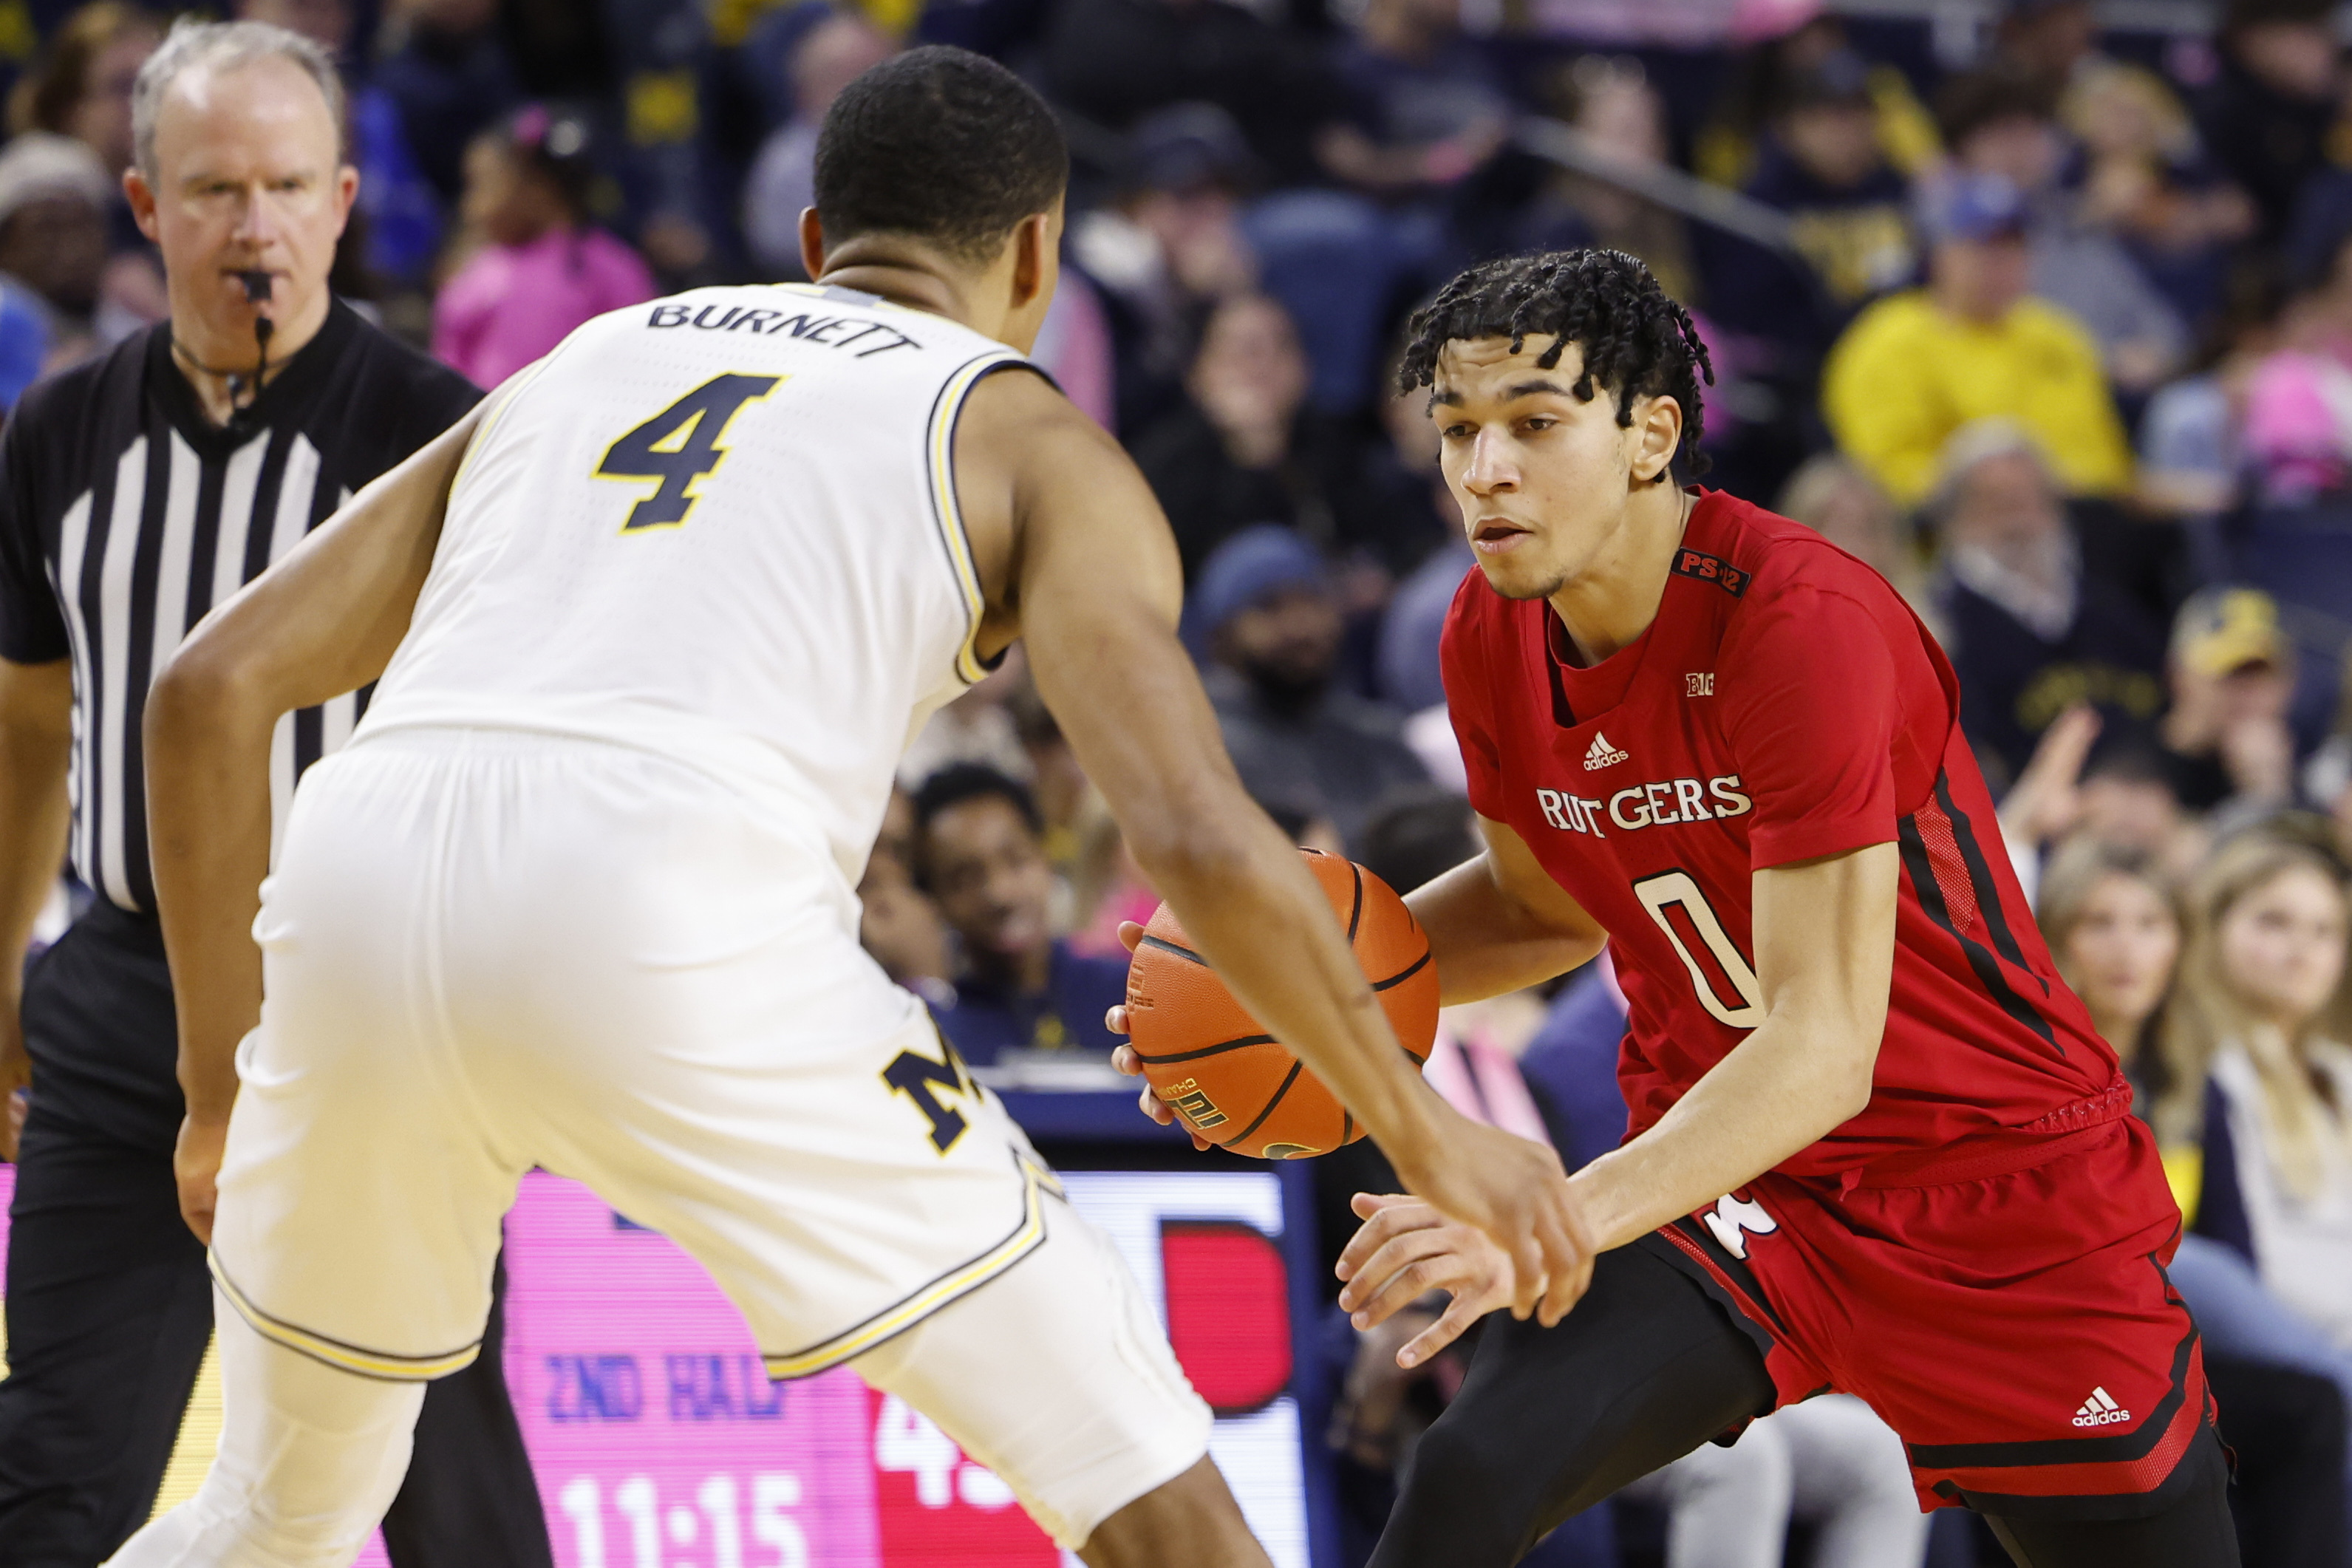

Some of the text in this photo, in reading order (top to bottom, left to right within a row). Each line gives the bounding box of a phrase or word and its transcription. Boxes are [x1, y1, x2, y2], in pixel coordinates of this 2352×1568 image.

[648, 304, 924, 358] BURNETT
[590, 371, 793, 536] 4
[1583, 750, 1629, 771] adidas
[1536, 774, 1753, 839] RUTGERS
[1631, 867, 1768, 1029] 0
[664, 1354, 788, 1422] HAL
[2072, 1409, 2130, 1427] adidas
[875, 1391, 1018, 1513] 4
